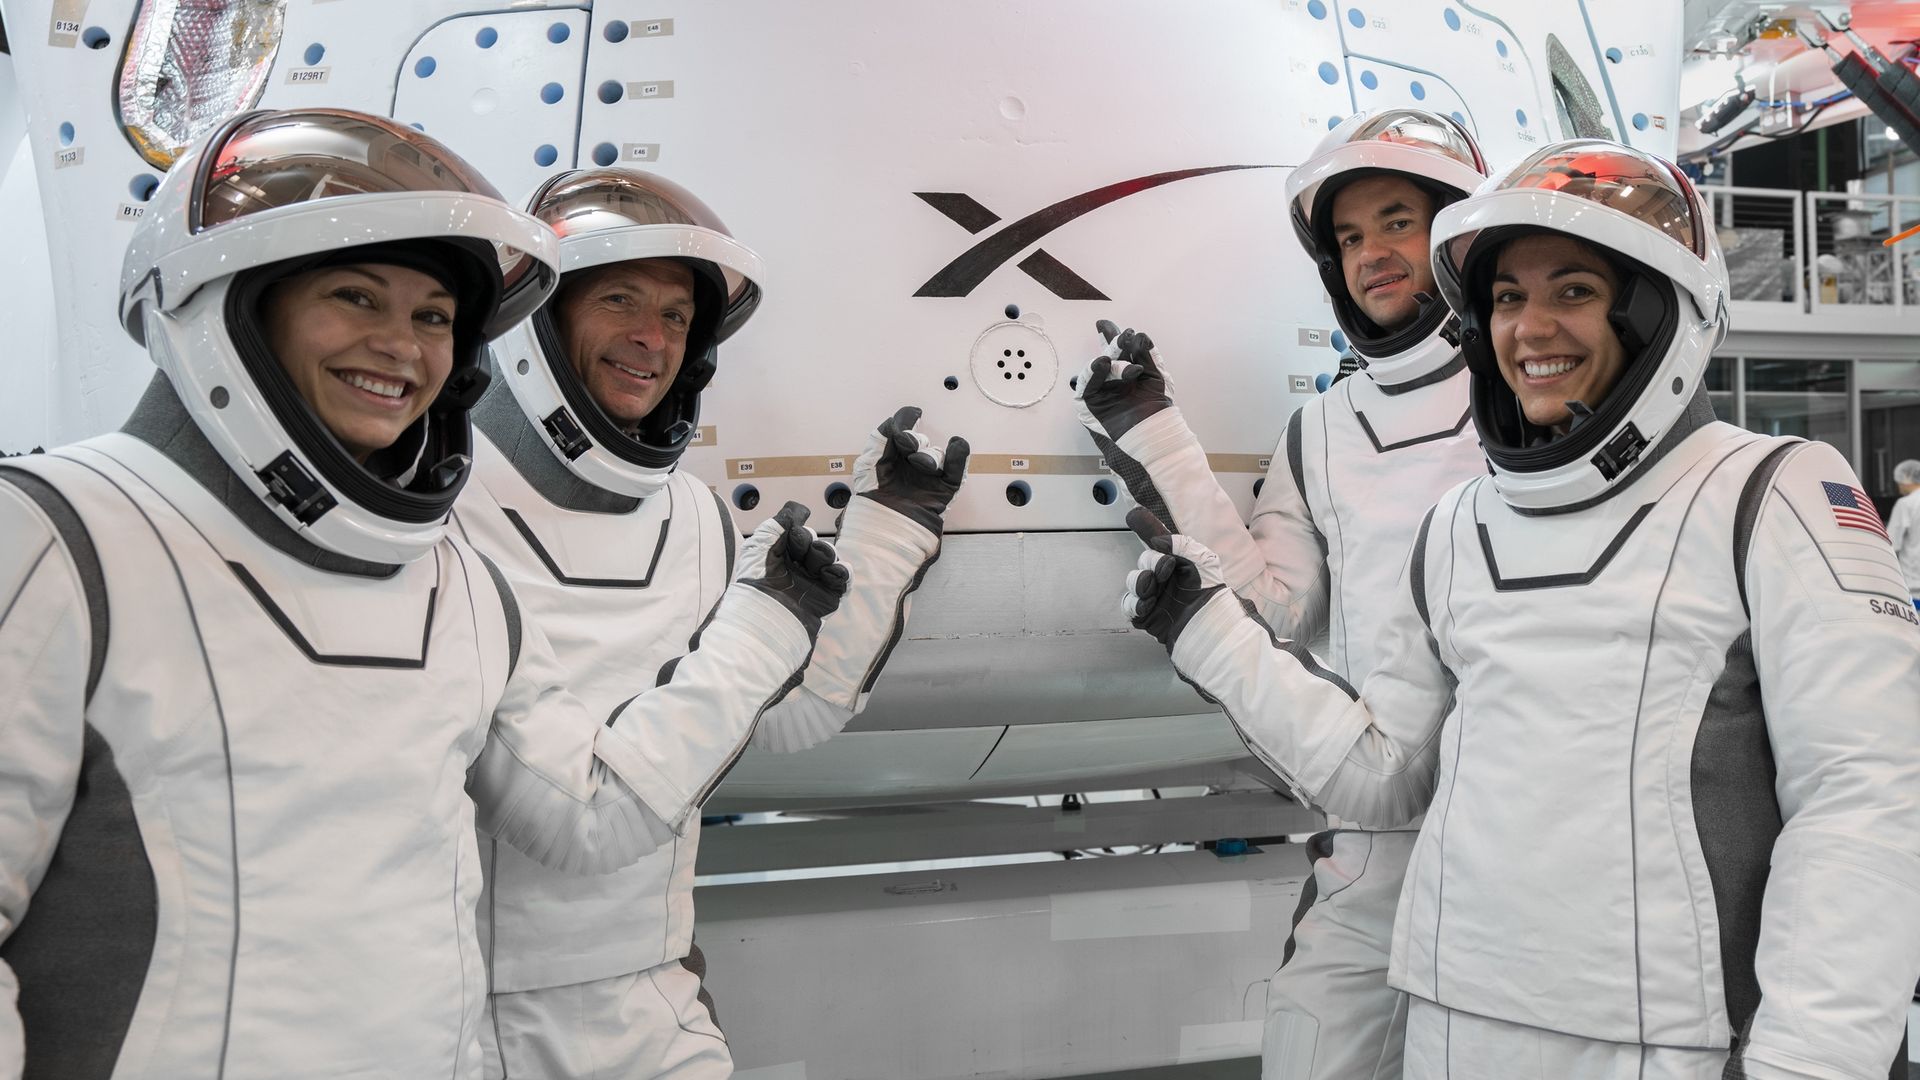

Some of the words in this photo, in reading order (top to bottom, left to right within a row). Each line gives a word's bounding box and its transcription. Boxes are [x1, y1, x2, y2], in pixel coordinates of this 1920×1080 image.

[56, 21, 79, 32] B134
[292, 71, 325, 81] B129RT
[124, 206, 144, 218] B13
[740, 463, 753, 471] E39
